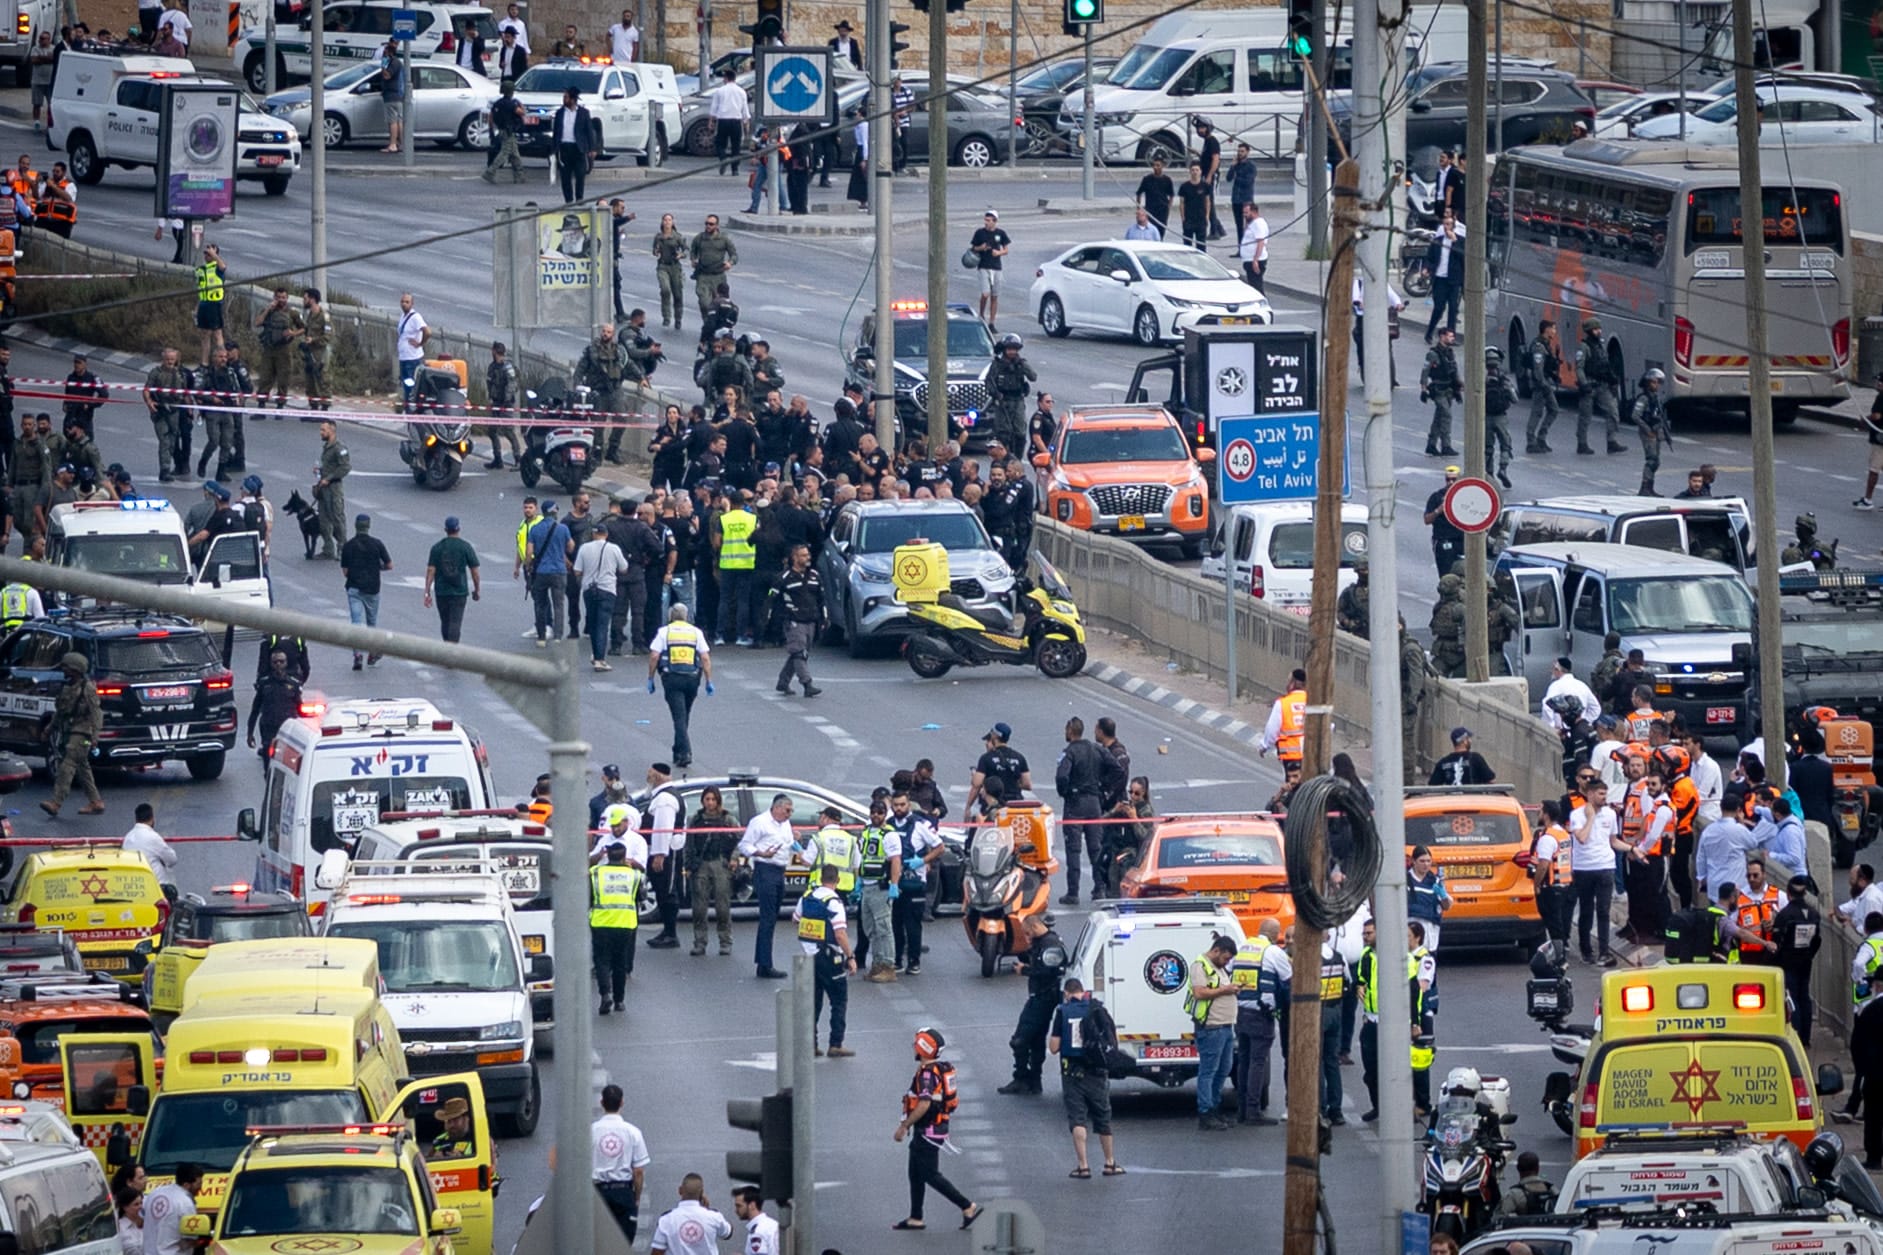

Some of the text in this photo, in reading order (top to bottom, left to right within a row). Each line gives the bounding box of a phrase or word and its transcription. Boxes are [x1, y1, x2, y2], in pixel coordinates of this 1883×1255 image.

[108, 121, 133, 133] POLICE
[541, 261, 576, 273] המלך
[1272, 374, 1298, 393] לב
[1265, 396, 1303, 407] הבירה
[1254, 424, 1313, 443] תל אביב
[1232, 454, 1249, 467] 4.8
[1263, 446, 1306, 469] تل أبيب
[1257, 473, 1312, 489] Tel Aviv
[784, 877, 807, 885] LICE
[46, 913, 65, 922] 101
[1656, 1017, 1727, 1032] פראמדיק
[222, 1072, 292, 1085] פראמדיק
[1612, 1069, 1652, 1080] MAGEN
[1730, 1066, 1777, 1080] מגן דוד
[1613, 1079, 1647, 1089] DAVID
[1745, 1080, 1778, 1091] אדום
[1613, 1089, 1648, 1099] ADOM
[1726, 1092, 1777, 1105] בישראל
[1613, 1098, 1665, 1109] IN ISRAEL
[1620, 1183, 1700, 1193] משמר הגבול
